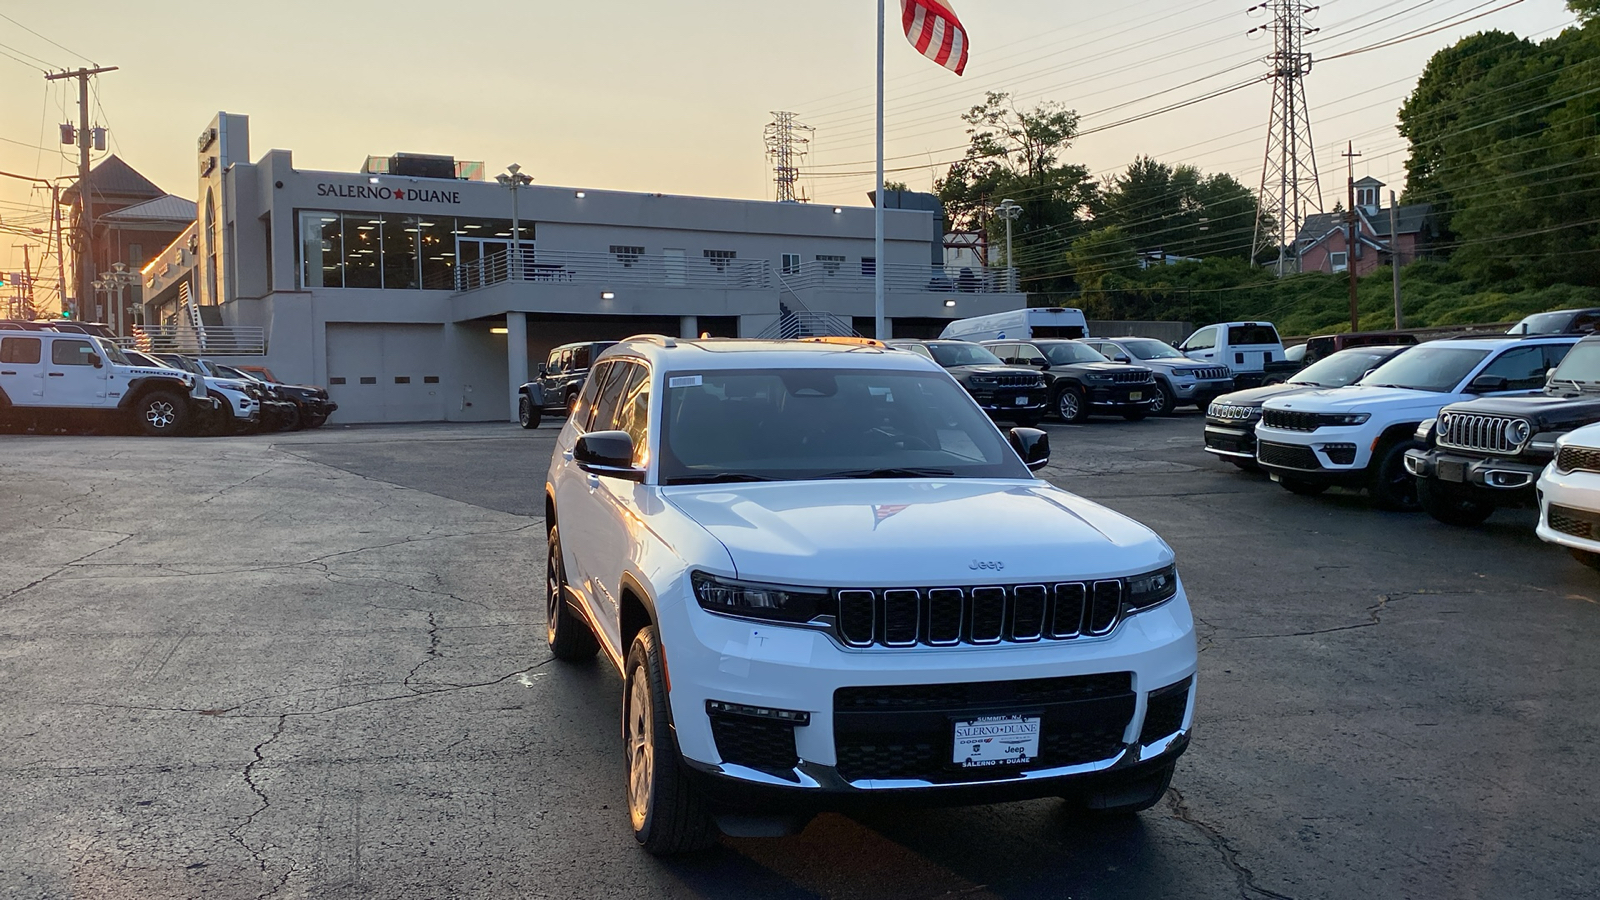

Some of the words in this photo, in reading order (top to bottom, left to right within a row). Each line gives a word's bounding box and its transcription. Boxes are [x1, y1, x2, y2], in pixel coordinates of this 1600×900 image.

[317, 183, 391, 200] SALERNO
[407, 188, 461, 204] DUANE
[130, 369, 178, 377] RUBICON
[968, 559, 1004, 571] Jeep
[956, 726, 999, 737] SALERNO
[1004, 724, 1037, 734] DUANE
[1004, 746, 1024, 754] Jeep
